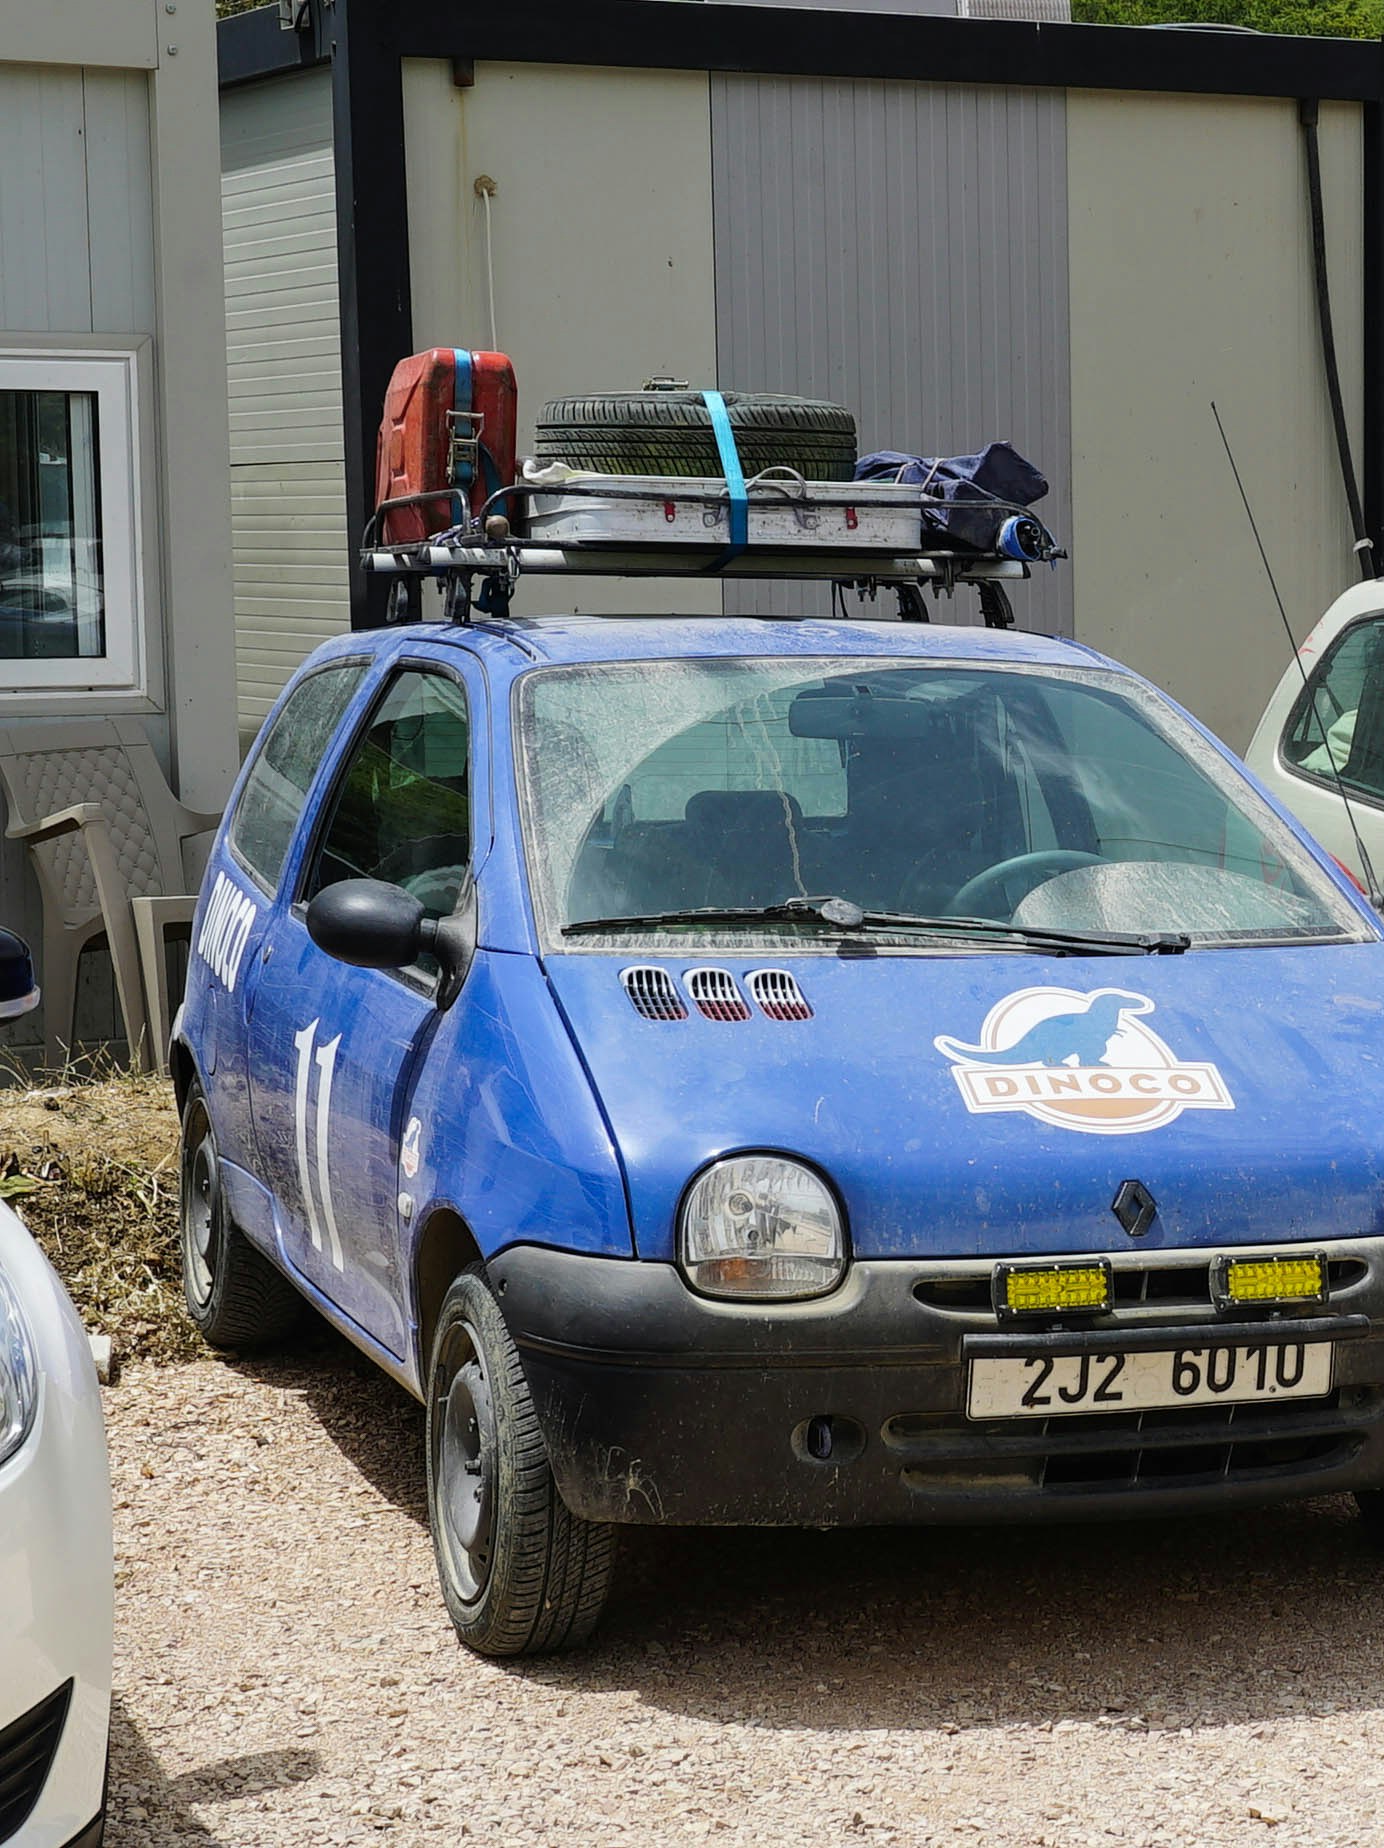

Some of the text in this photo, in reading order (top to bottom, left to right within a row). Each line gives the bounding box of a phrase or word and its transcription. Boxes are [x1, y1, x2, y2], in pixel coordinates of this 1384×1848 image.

[198, 870, 257, 993] DINOCO
[985, 1073, 1202, 1098] DINOCO
[294, 1016, 345, 1274] 11
[1021, 1343, 1304, 1406] 2J2 6010
